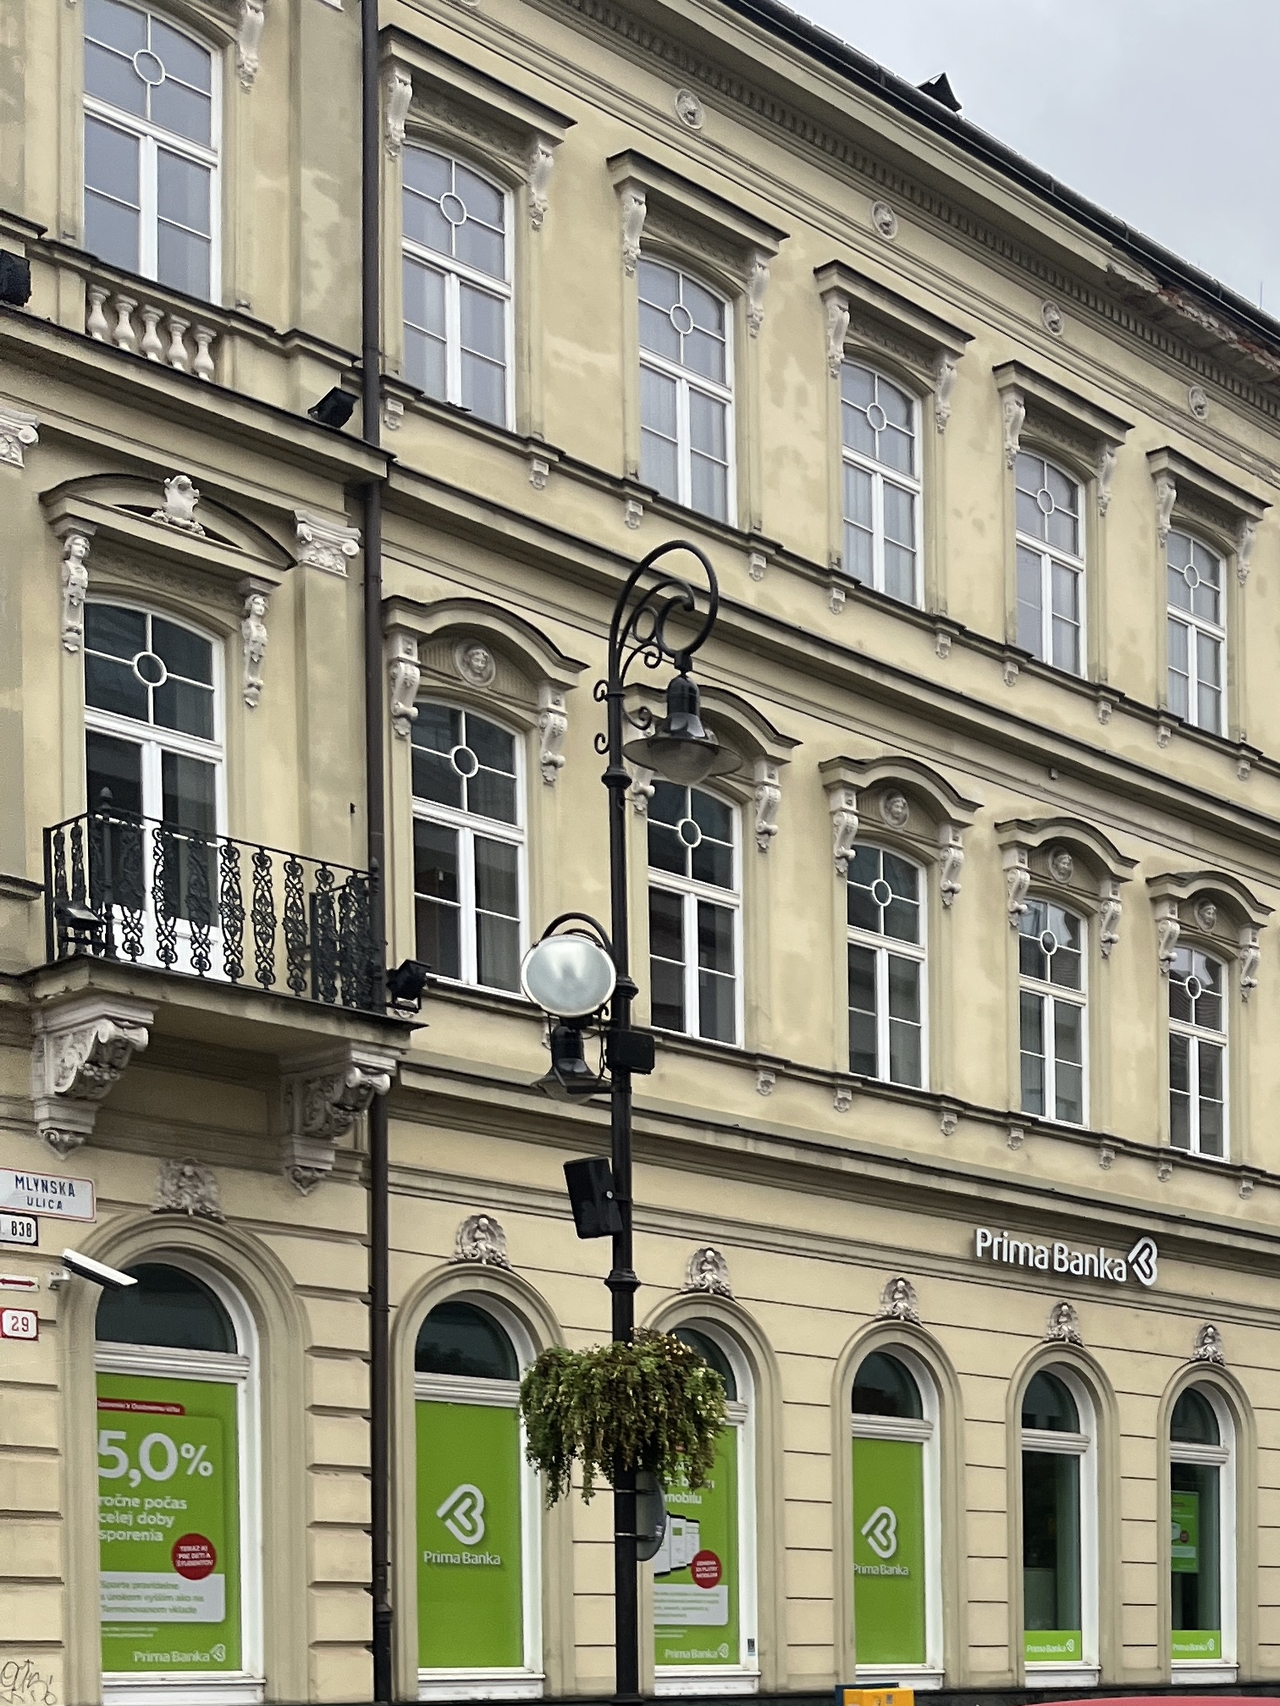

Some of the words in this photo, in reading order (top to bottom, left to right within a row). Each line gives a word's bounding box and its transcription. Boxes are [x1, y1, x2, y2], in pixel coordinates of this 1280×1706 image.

[26, 1196, 63, 1211] ULICA
[11, 1220, 32, 1238] 838
[975, 1228, 1049, 1270] Prima
[1053, 1242, 1127, 1282] Banka
[11, 1315, 30, 1333] 29
[98, 1430, 213, 1488] 5,0%
[98, 1494, 140, 1508] ročne
[144, 1496, 188, 1511] počas
[99, 1511, 133, 1527] celej
[137, 1512, 175, 1528] doby
[98, 1529, 164, 1543] sporenia
[423, 1550, 461, 1564] Prima
[462, 1551, 501, 1566] Banka
[853, 1563, 879, 1575] Prima
[880, 1563, 909, 1576] Banka
[134, 1650, 170, 1662] Prima
[172, 1650, 210, 1663] Banka
